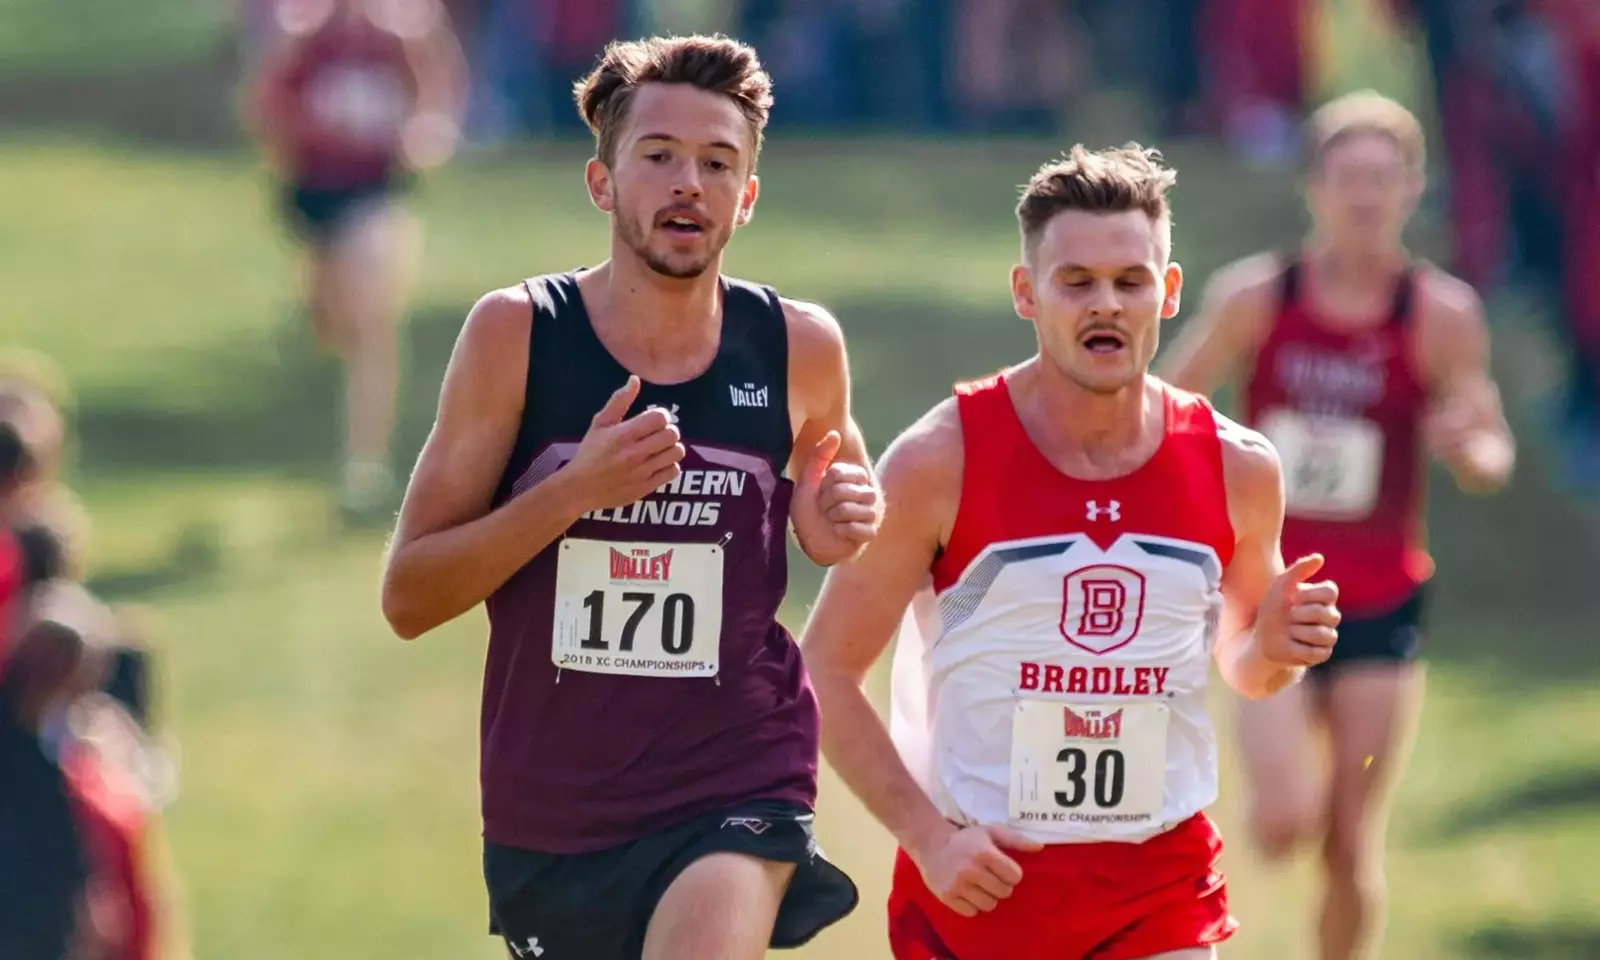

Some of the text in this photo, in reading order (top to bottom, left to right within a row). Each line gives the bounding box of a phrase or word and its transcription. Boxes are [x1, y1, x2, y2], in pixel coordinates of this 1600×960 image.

[729, 384, 768, 408] VALLEY
[744, 382, 755, 390] THE
[656, 470, 747, 497] HERN
[609, 546, 674, 581] VALLEY
[631, 548, 650, 557] THE
[580, 589, 695, 656] 170
[1076, 579, 1127, 637] B
[563, 653, 706, 671] 2018 XC CHAMPIONSHIPS
[1019, 661, 1170, 696] BRADLEY
[1063, 706, 1124, 739] VALLEY
[1054, 747, 1126, 809] 30
[1019, 811, 1152, 824] 2018 XC CHAMPIONSHIPS
